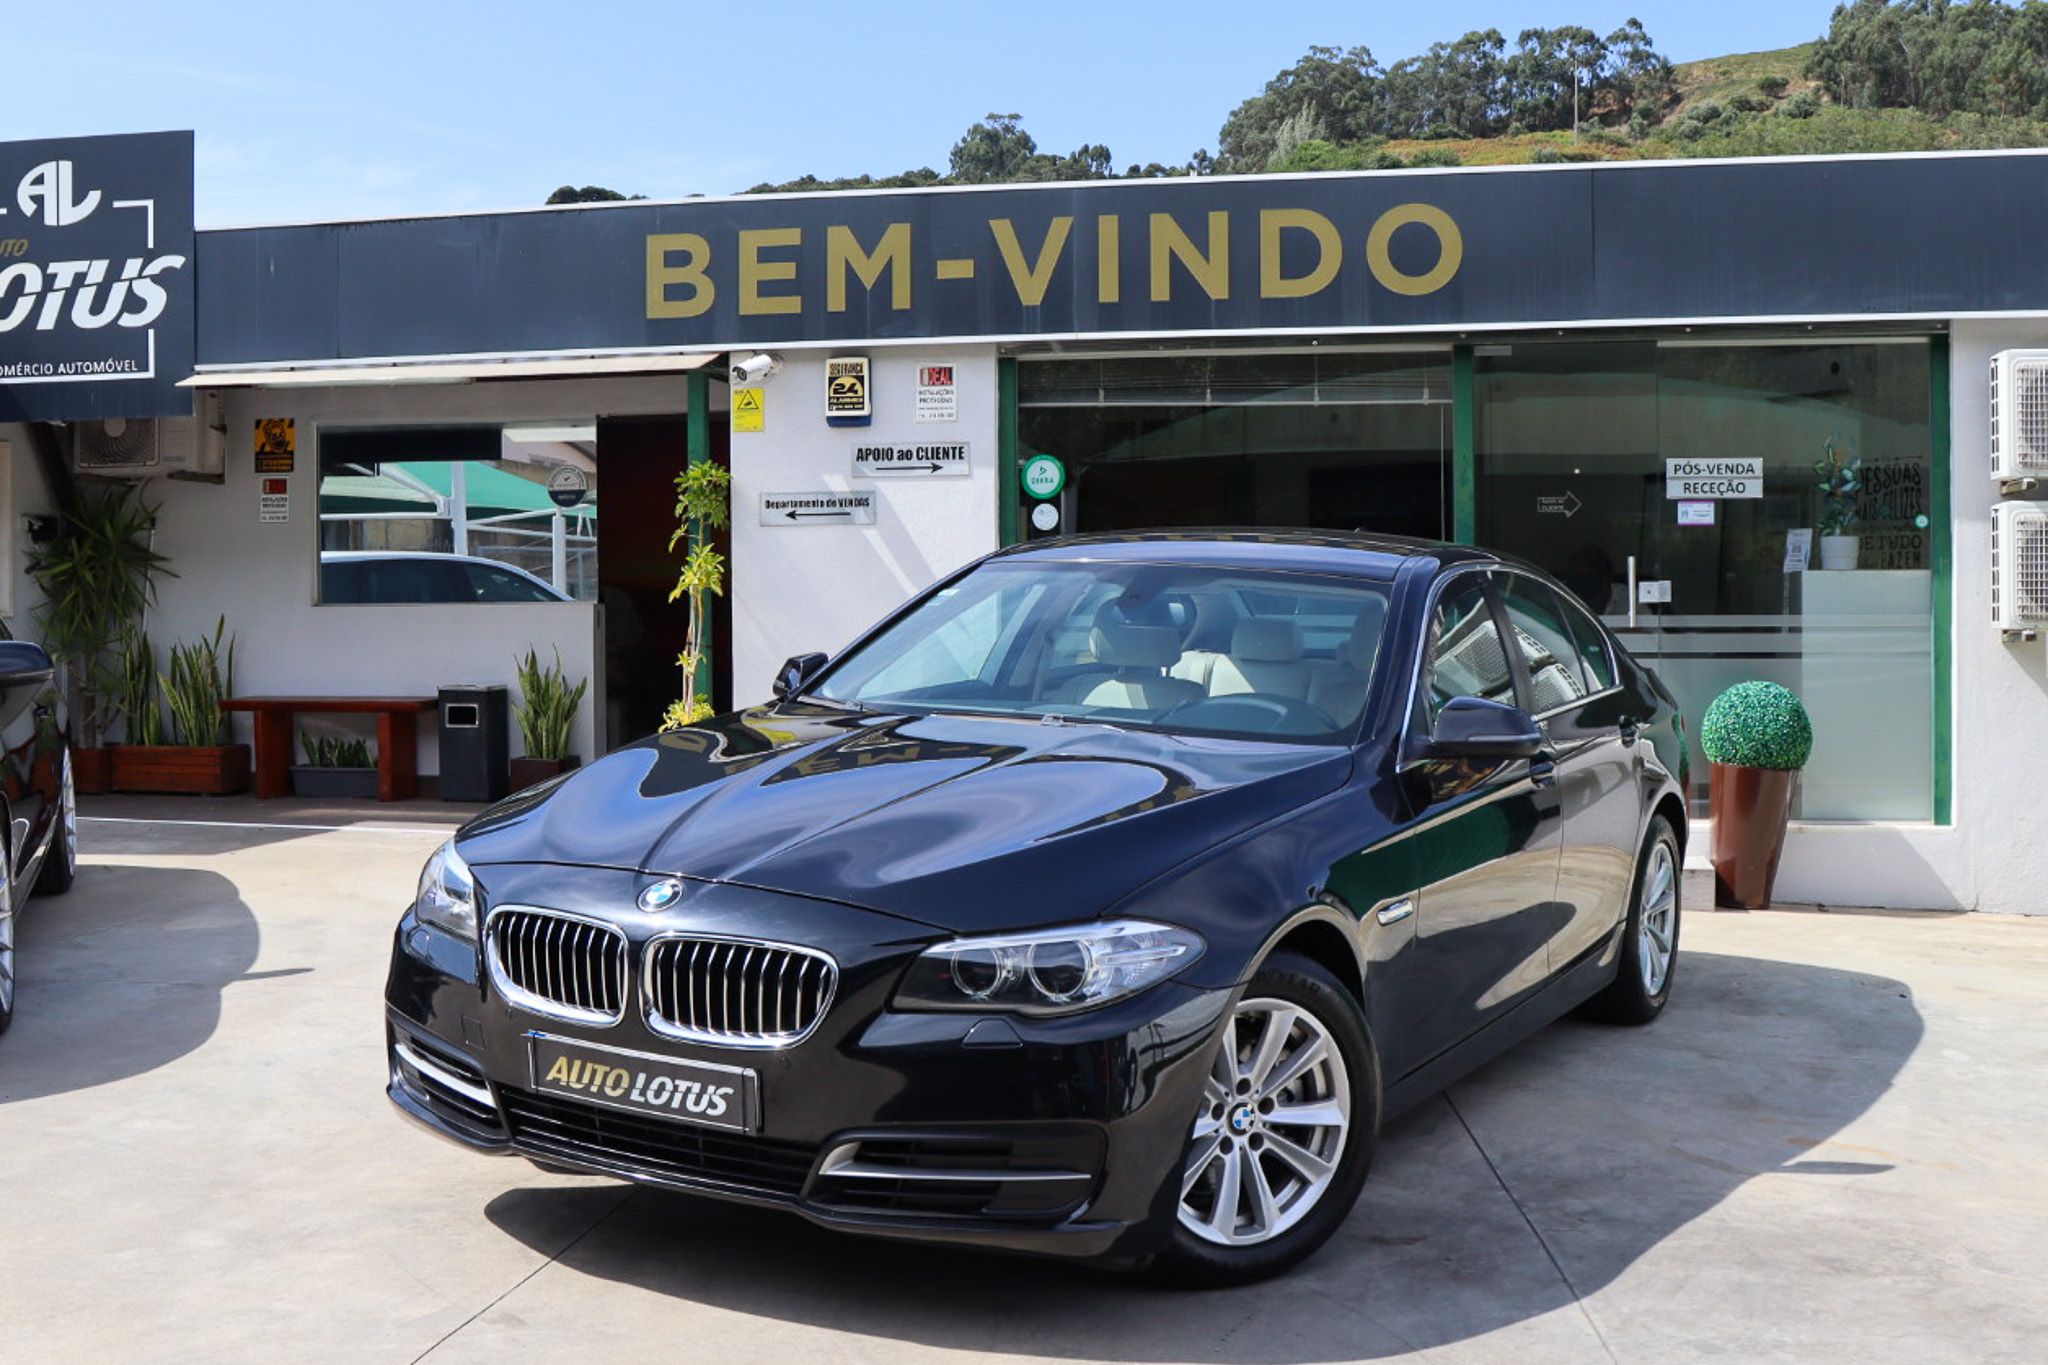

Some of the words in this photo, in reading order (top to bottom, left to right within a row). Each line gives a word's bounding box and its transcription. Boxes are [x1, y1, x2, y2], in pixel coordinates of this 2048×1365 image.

[645, 202, 1464, 320] BEM-VINDO
[58, 357, 138, 374] AUTOMÓVEL
[833, 383, 859, 395] 24
[856, 447, 894, 462] APOIO
[897, 449, 913, 461] ao
[916, 446, 965, 461] CLIENTE
[1673, 461, 1756, 475] PÓS-VENDA
[1683, 479, 1746, 495] RECEÇÃO
[765, 499, 825, 509] Departamento
[837, 497, 870, 508] VENDAS
[546, 1056, 630, 1097] AUTO
[630, 1073, 734, 1116] LOTUS
